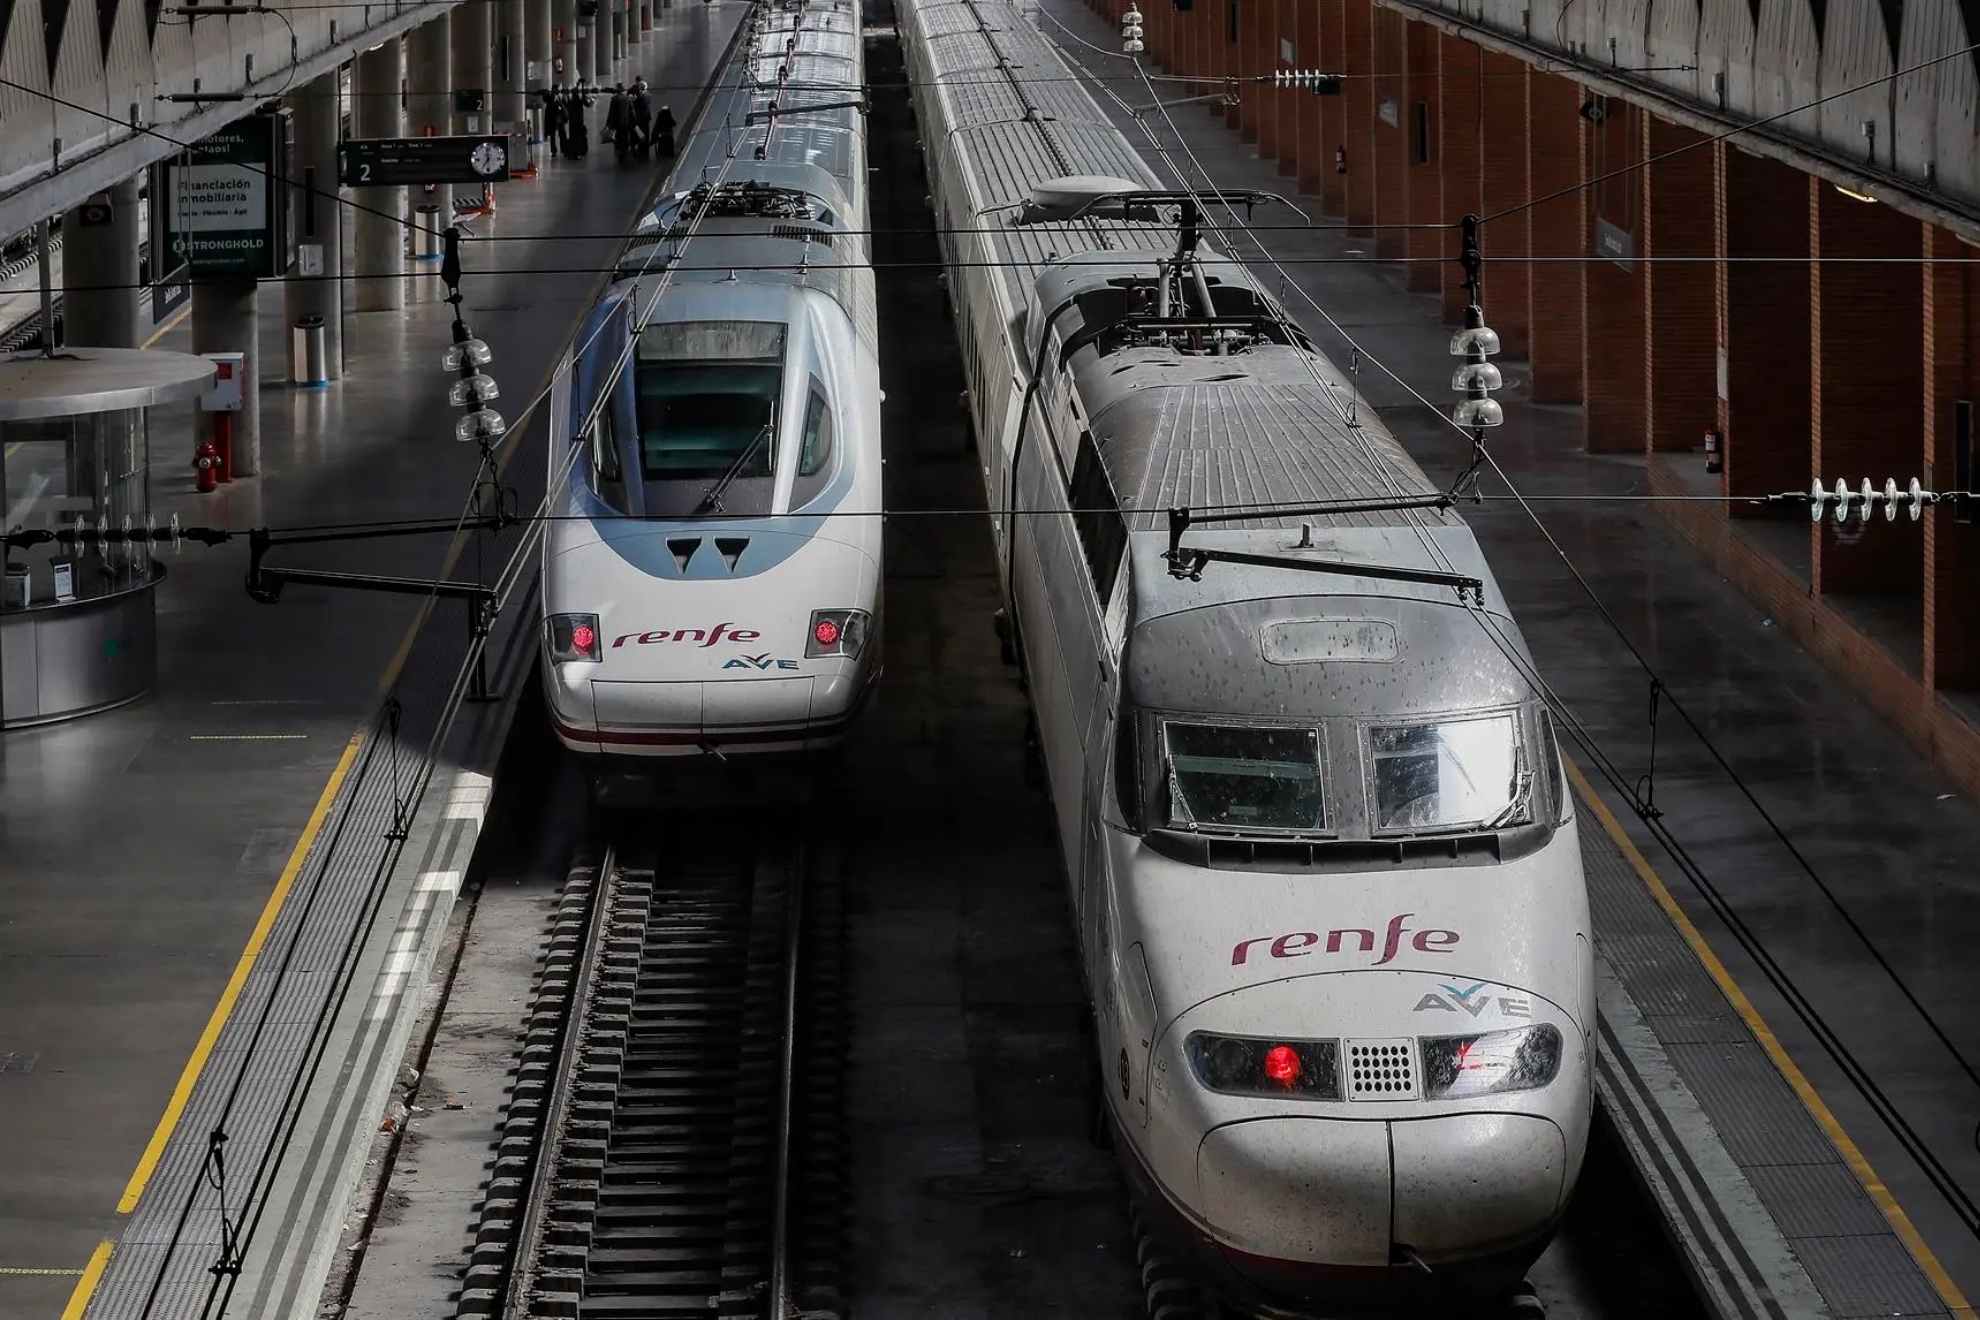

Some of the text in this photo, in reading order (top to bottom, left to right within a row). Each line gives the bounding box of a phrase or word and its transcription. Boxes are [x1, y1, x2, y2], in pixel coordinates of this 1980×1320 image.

[476, 99, 484, 111] 2
[197, 135, 244, 144] motores,
[359, 163, 371, 182] 2
[187, 239, 264, 250] STRONGHOLD
[611, 622, 761, 648] renfe
[721, 653, 799, 670] AVE
[1231, 912, 1460, 966] renfe
[1412, 985, 1532, 1018] AVE
